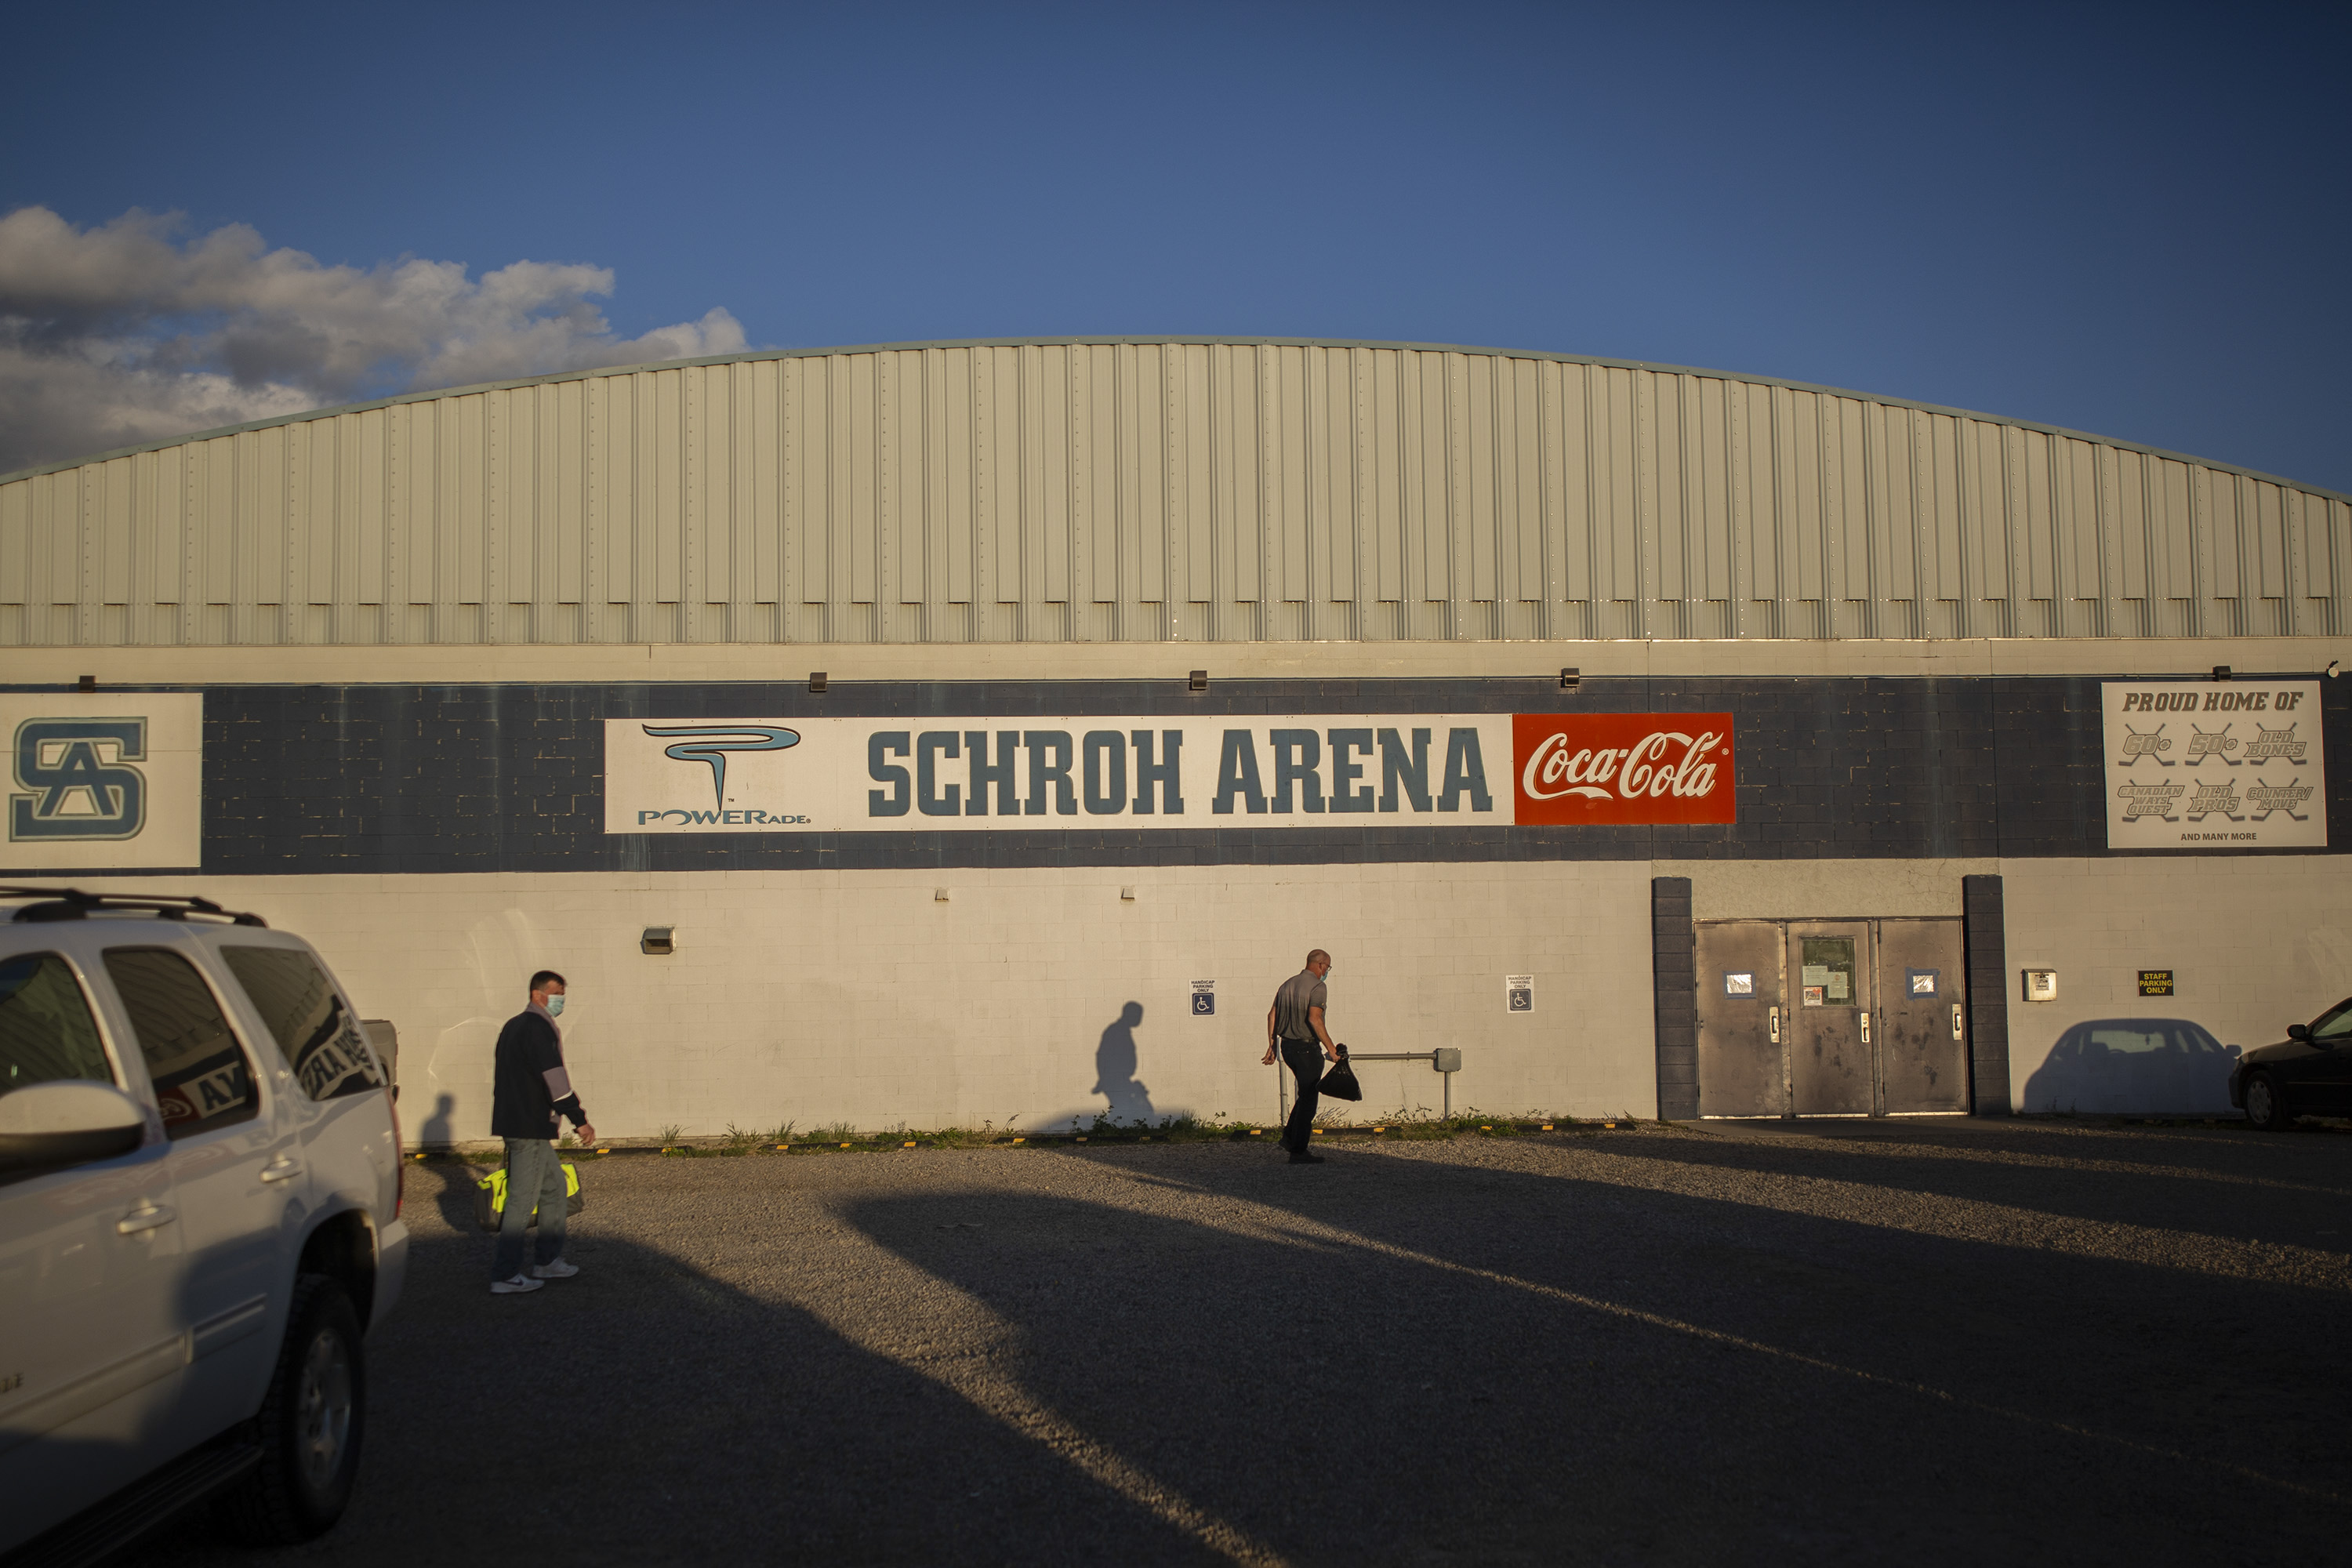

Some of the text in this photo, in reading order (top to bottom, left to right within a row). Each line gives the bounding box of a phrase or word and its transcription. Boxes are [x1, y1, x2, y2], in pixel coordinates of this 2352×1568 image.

[2122, 691, 2304, 712] PROUD HOME OF
[2259, 731, 2293, 743] OLD
[2123, 734, 2172, 754] 60+
[2187, 733, 2238, 754] 50+
[2246, 743, 2304, 756] BONES
[868, 727, 1494, 817] SCHROH ARENA
[1523, 731, 1724, 801] Coca-Cola
[2119, 786, 2183, 797] CANADIAN
[2198, 786, 2232, 798] OLD
[2134, 797, 2169, 805] WAYS
[2190, 798, 2238, 811] PROS
[2260, 798, 2297, 809] MOVE
[2129, 804, 2170, 814] QUEST
[2180, 832, 2257, 841] AND MANY MORE
